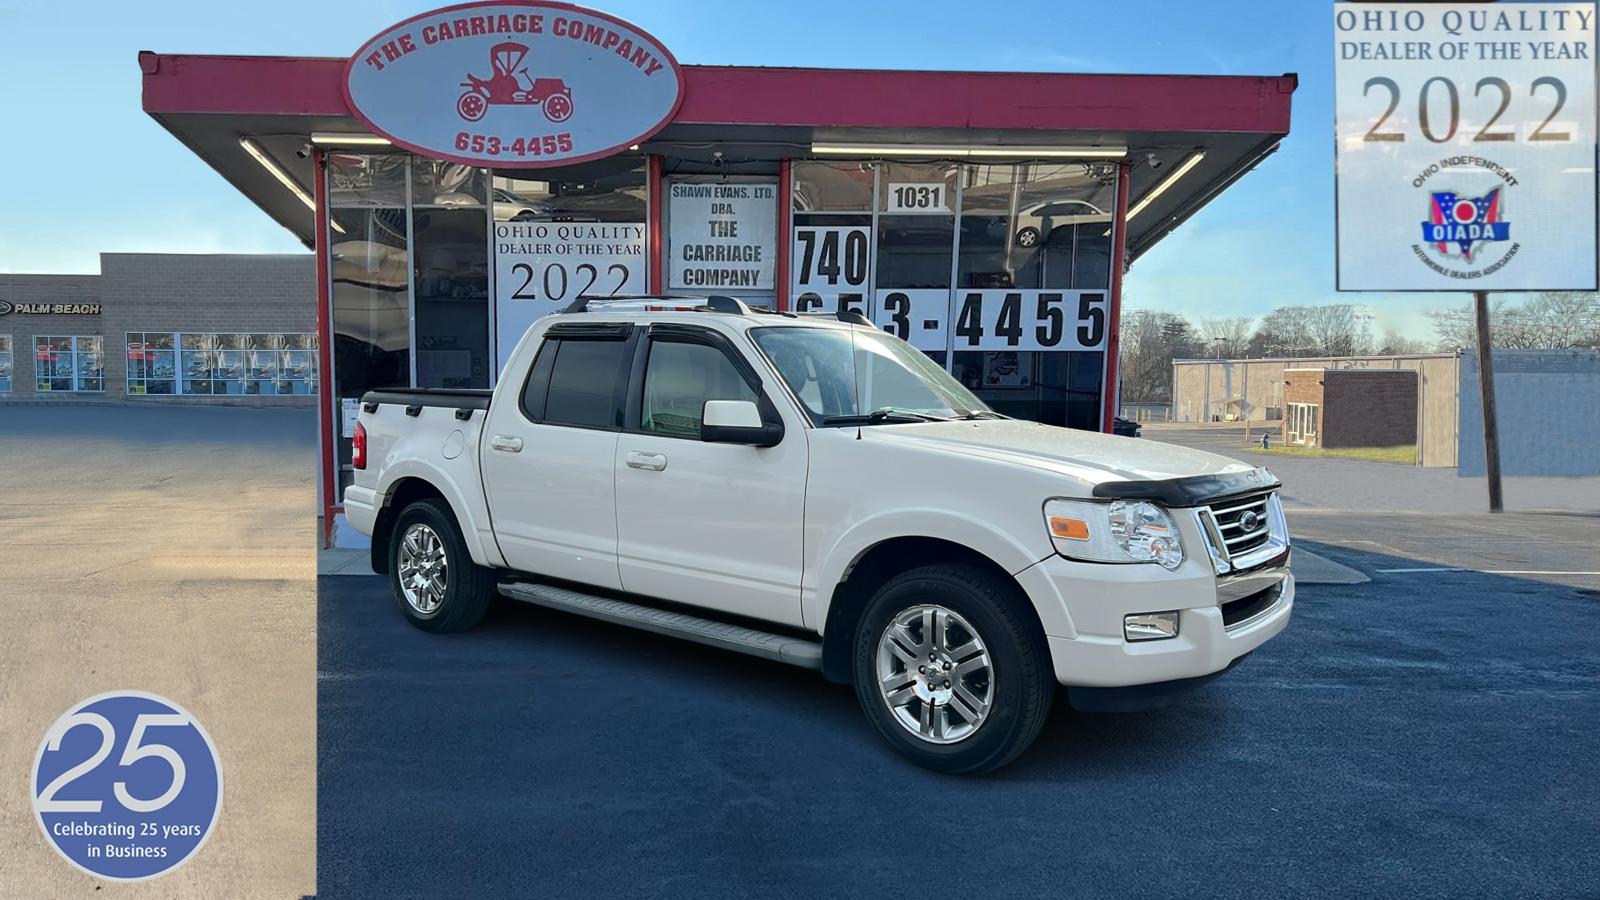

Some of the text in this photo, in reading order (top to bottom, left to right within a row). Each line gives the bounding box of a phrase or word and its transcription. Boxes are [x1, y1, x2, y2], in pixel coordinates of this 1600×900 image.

[1336, 9, 1593, 36] OHIO QUALITY
[365, 14, 665, 78] THE CARRIAGE COMPANY
[1340, 41, 1590, 60] DEALER OF THE YEAR
[1362, 75, 1571, 144] 2022
[454, 132, 574, 157] 653-4455
[1412, 155, 1519, 188] OHIO INDEPENDENT
[672, 185, 712, 199] SHAWN
[754, 187, 775, 200] LTD.
[893, 186, 941, 208] 1031
[711, 202, 736, 215] DBA.
[496, 225, 644, 241] OHIO QUALITY
[708, 220, 738, 238] THE
[1432, 224, 1496, 241] OIADA
[500, 243, 642, 255] DEALER OF THE YEAR
[683, 244, 763, 262] CARRIAGE
[797, 230, 869, 287] 740
[1411, 244, 1450, 277] AUTOMOBILE
[511, 262, 630, 301] 2022
[683, 268, 761, 286] COMPANY
[15, 303, 100, 314] PALM BEACH
